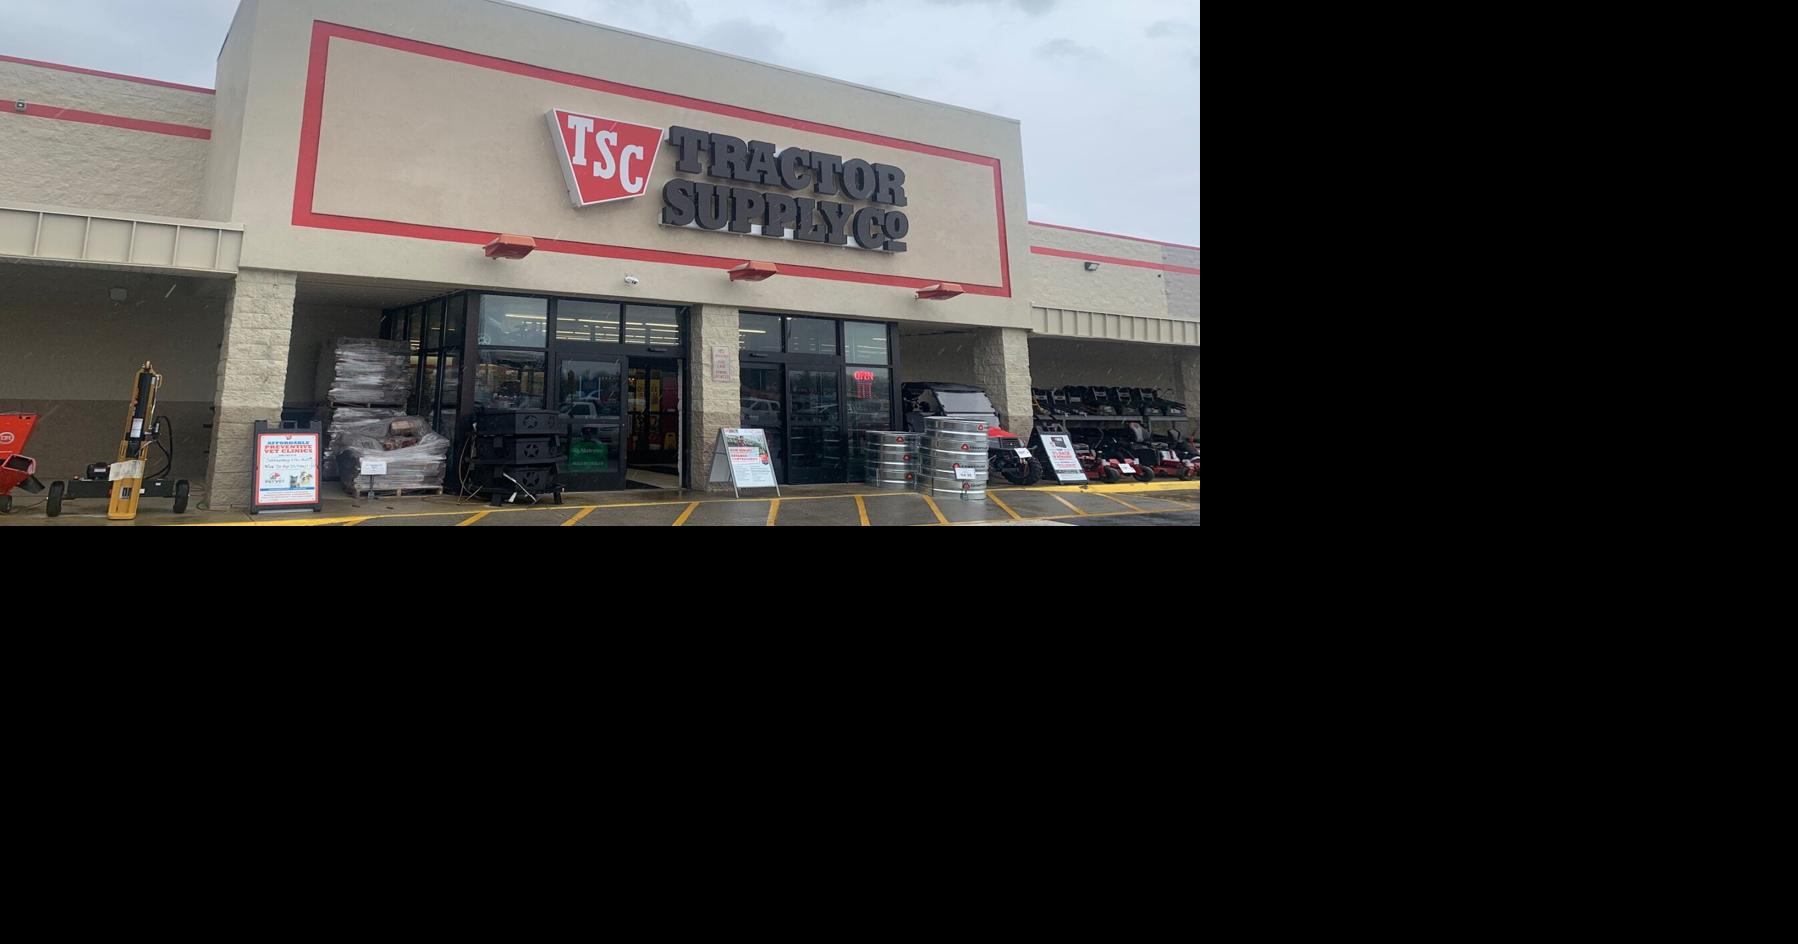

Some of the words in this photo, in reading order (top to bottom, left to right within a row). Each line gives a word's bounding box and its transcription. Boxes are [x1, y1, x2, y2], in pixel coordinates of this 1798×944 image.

[567, 114, 644, 193] TSC
[669, 126, 907, 207] TRACTOR
[662, 178, 854, 244] SUPPLY
[854, 371, 874, 381] OPEN
